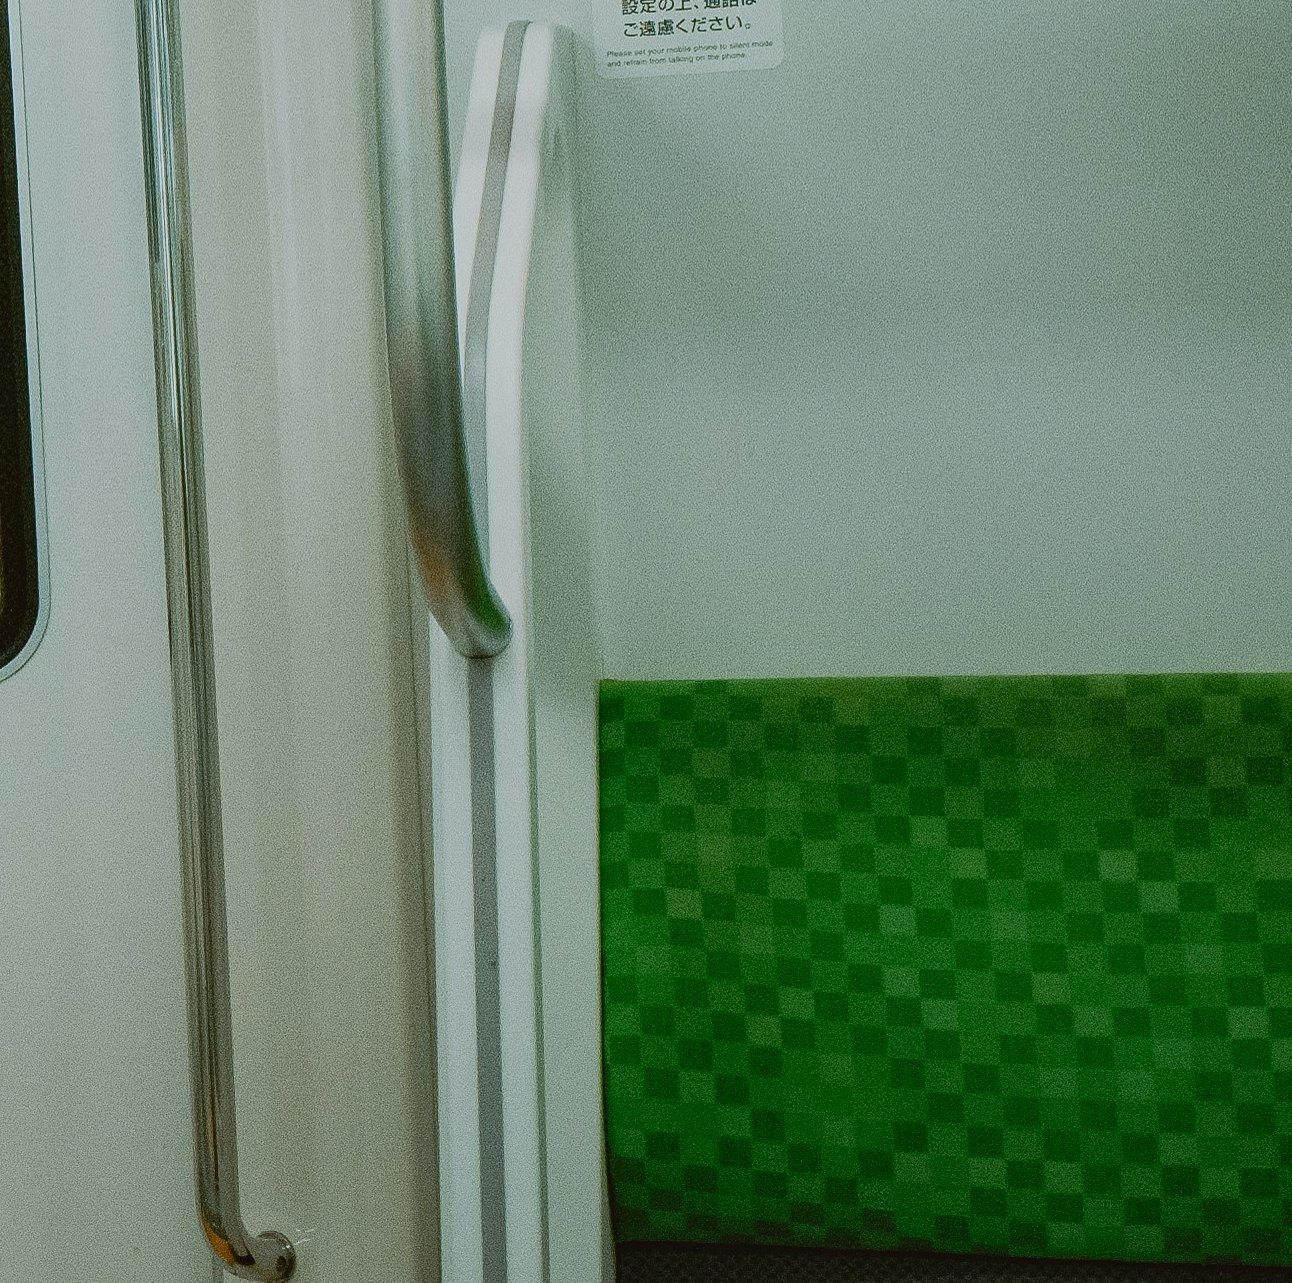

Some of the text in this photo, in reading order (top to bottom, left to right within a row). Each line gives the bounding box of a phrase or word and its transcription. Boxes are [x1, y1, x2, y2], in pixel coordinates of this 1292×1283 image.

[623, 16, 752, 38] ご遠慮ください。
